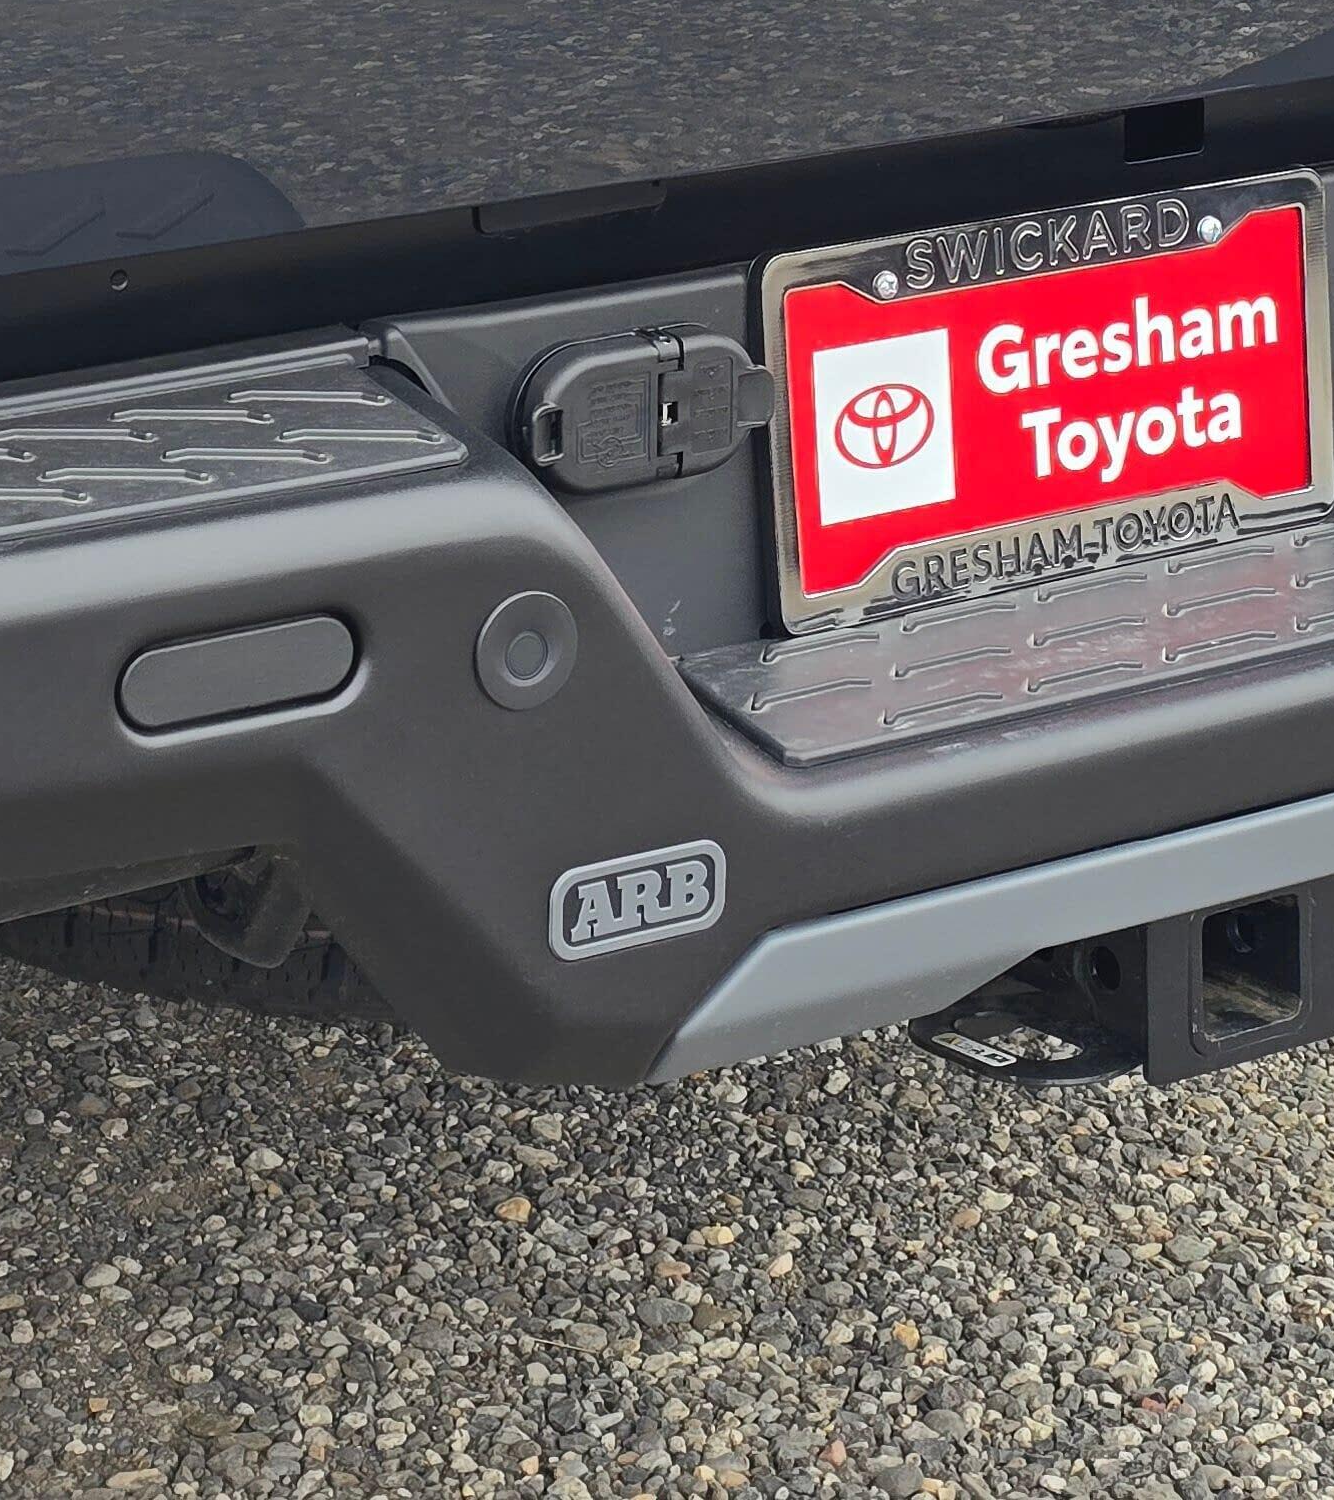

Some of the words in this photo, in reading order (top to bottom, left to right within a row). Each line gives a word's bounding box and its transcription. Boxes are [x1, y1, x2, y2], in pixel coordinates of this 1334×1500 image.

[904, 197, 1191, 290] SWICKARD
[976, 293, 1279, 396] Gresham
[1019, 385, 1243, 485] Toyota
[888, 523, 1084, 602] GRESHAM
[1093, 491, 1240, 552] TOYOTA
[570, 859, 710, 943] ARB
